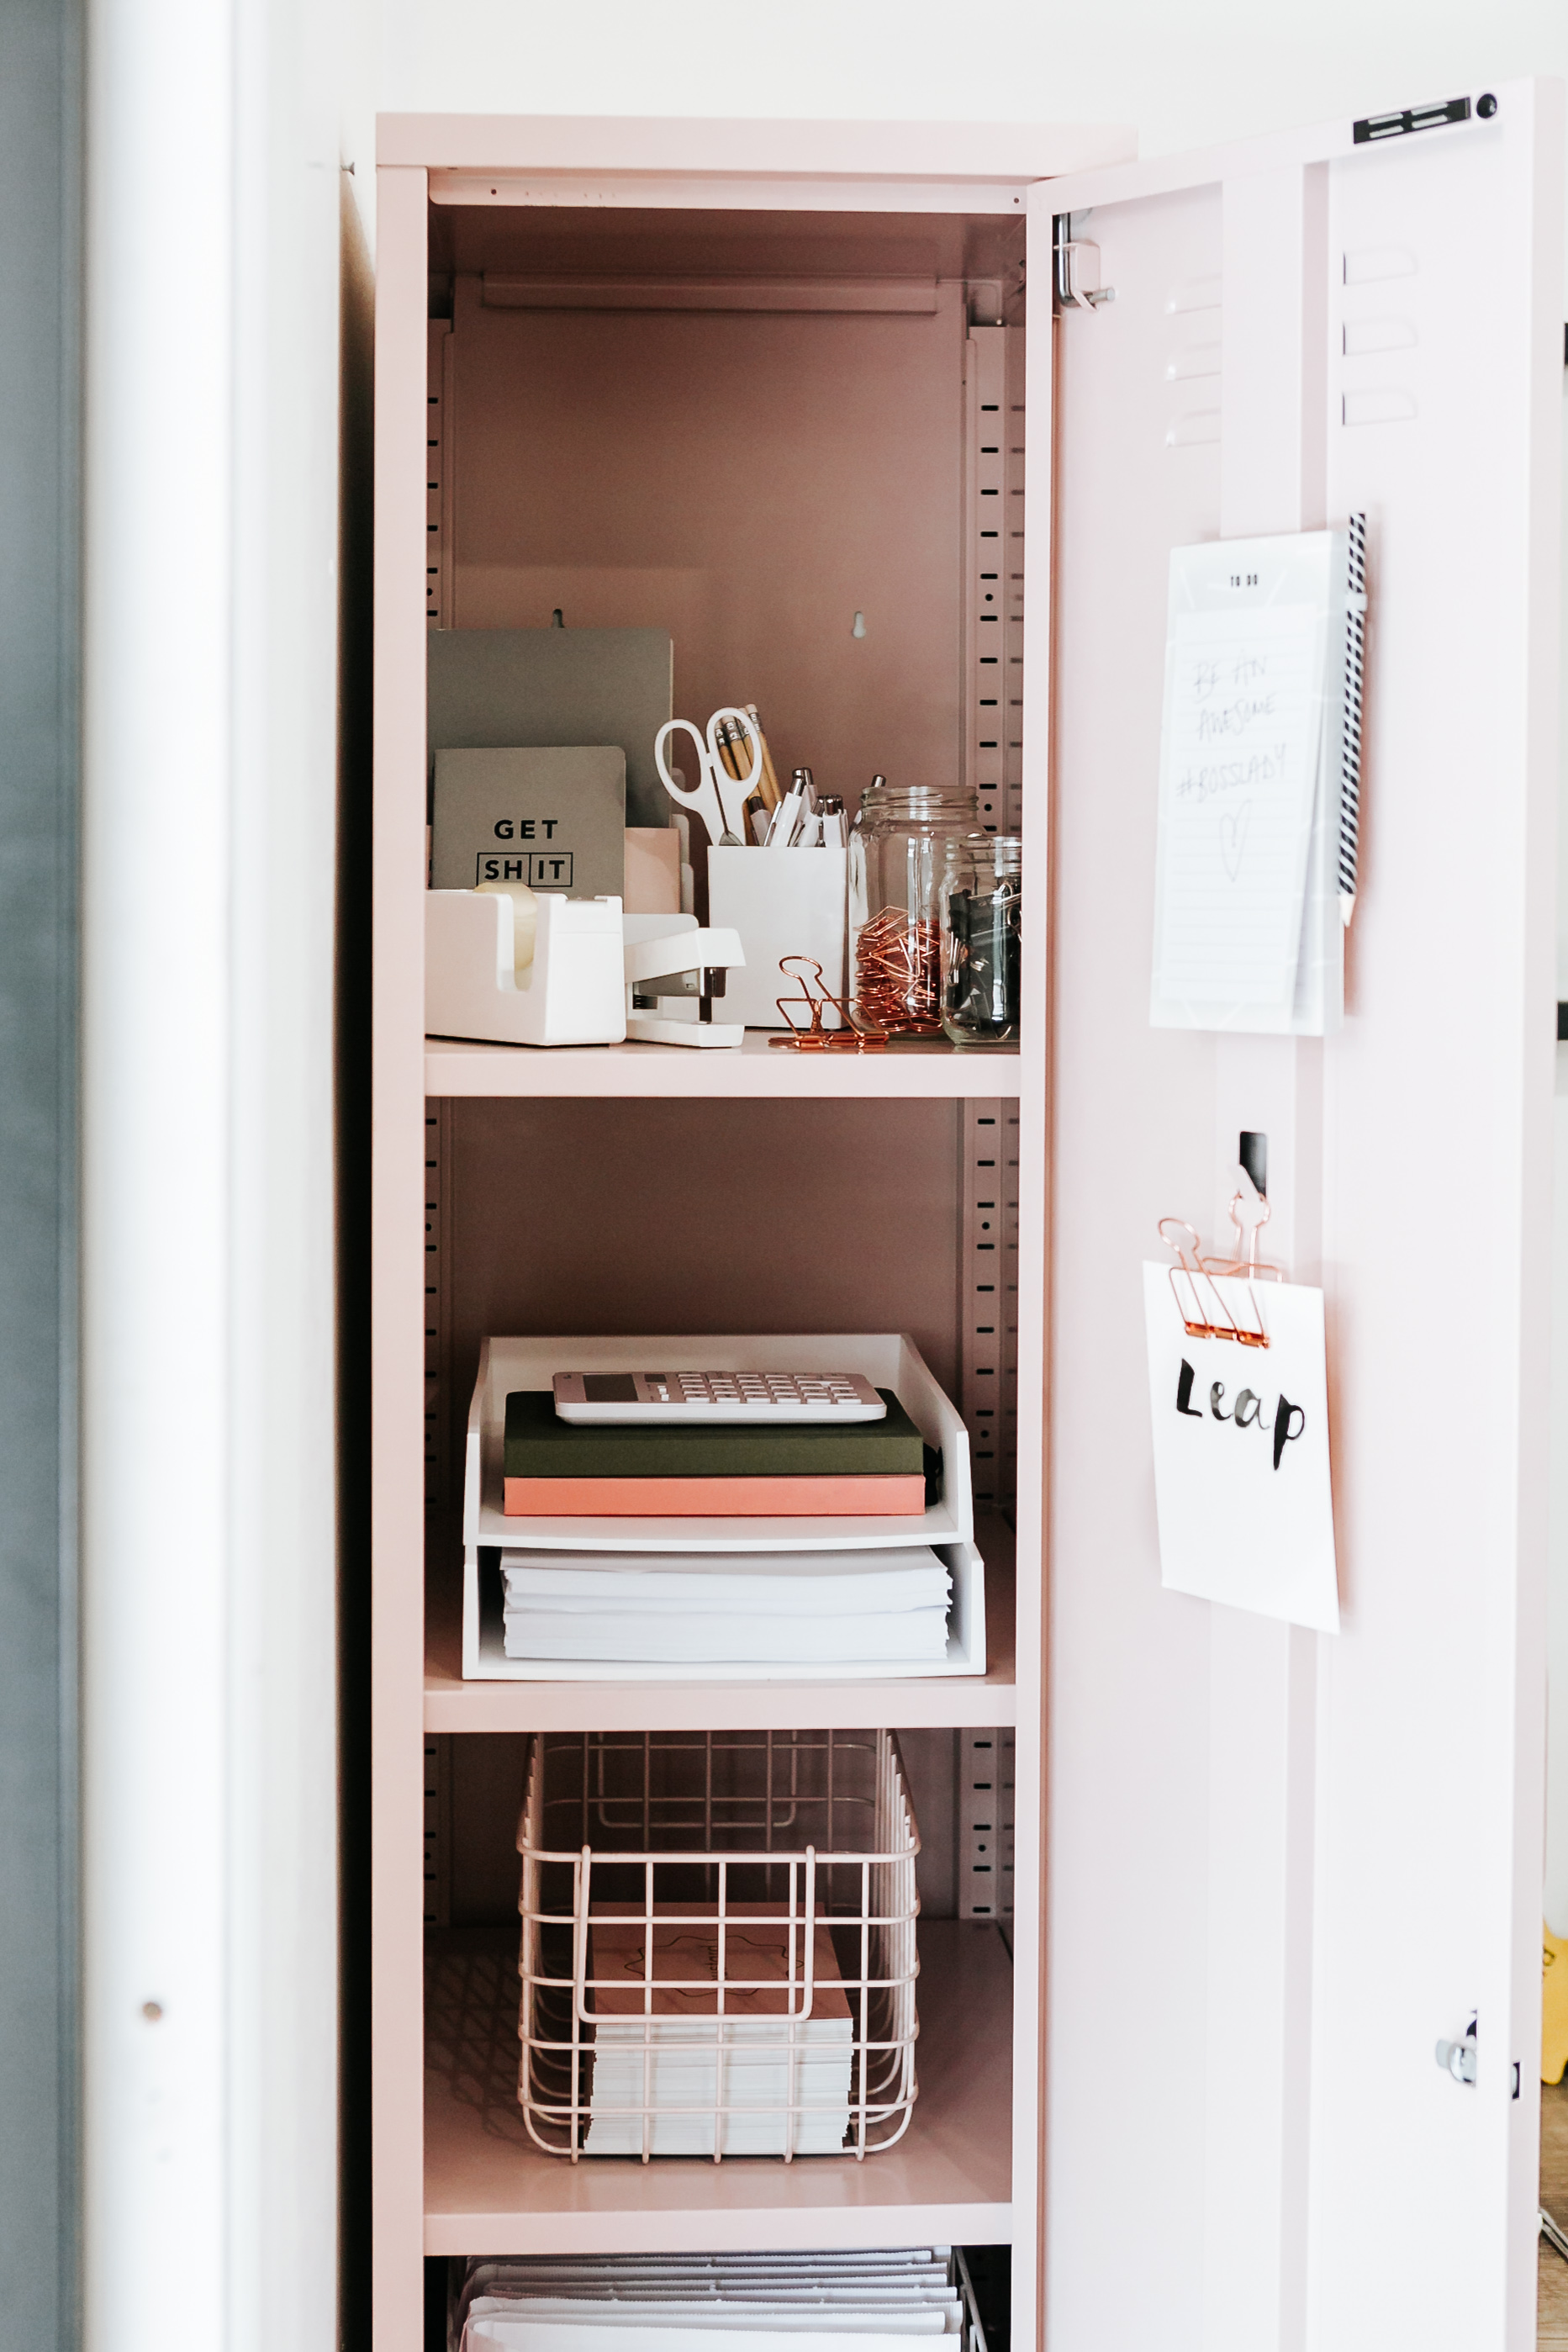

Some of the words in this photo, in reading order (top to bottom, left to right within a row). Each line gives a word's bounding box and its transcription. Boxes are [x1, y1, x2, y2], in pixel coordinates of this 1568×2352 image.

[1191, 659, 1222, 705] BE
[1231, 648, 1269, 686] AN
[1196, 692, 1277, 743] AWESOME
[1175, 741, 1288, 804] #BOSSLADY
[494, 819, 558, 840] GET
[1176, 1357, 1305, 1471] Leap
